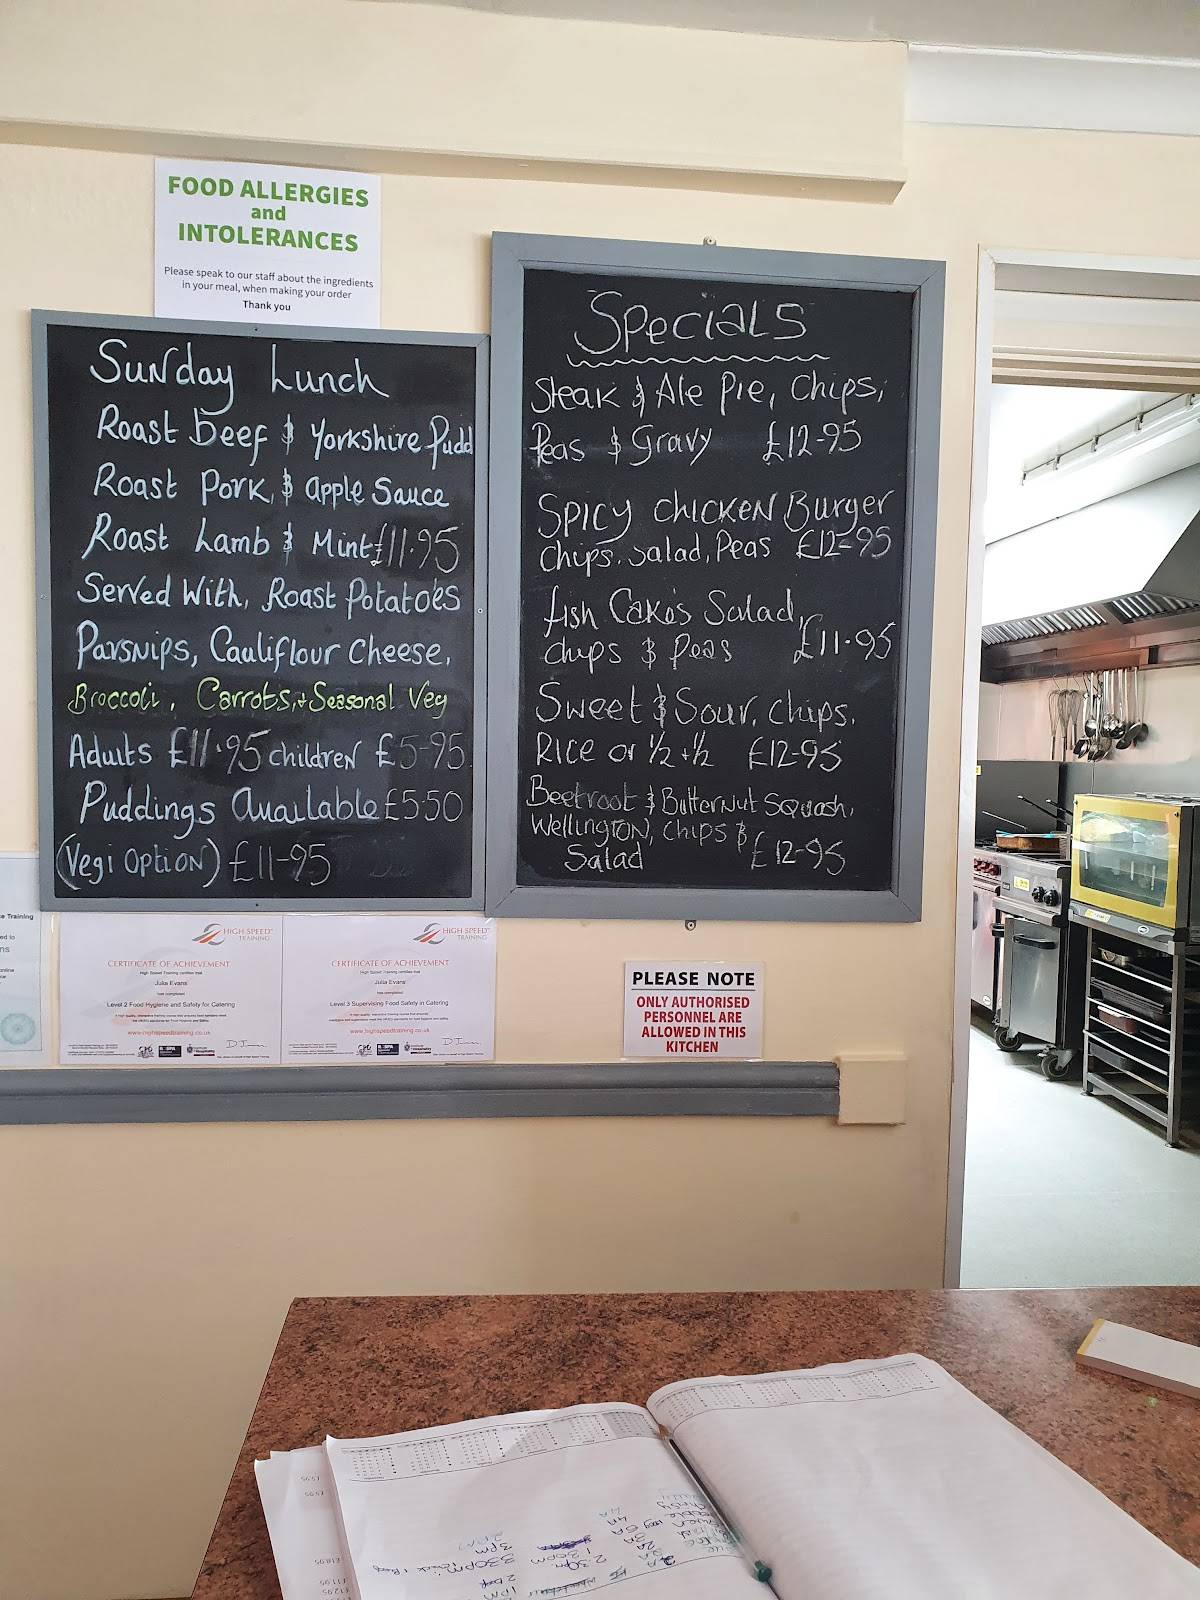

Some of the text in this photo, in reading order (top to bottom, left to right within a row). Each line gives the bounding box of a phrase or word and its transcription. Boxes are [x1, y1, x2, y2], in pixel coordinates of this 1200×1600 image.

[168, 176, 369, 208] FOOD ALLERGIES
[251, 205, 286, 221] and
[178, 223, 359, 252] INTOLERANCES
[164, 267, 194, 276] Please
[197, 268, 223, 279] speak
[237, 272, 253, 280] our
[255, 272, 275, 281] staff
[277, 273, 304, 284] about
[306, 275, 322, 285] the
[323, 276, 374, 288] ingredients
[182, 280, 352, 299] in your meal, when making your order
[243, 300, 291, 312] Thank you
[271, 343, 389, 397] Lunch
[531, 376, 620, 414] Steak
[657, 373, 703, 408] Ale
[97, 403, 179, 446] Roast
[311, 418, 421, 460] Yorkshire
[420, 414, 473, 470] Pudd
[530, 422, 585, 467] Peas
[629, 424, 713, 466] Gravy
[93, 462, 178, 497] Roast
[372, 476, 450, 508] Sauce
[537, 493, 632, 545] Spicy
[783, 490, 895, 537] Burger
[81, 512, 170, 559] Roast
[194, 517, 270, 556] Lamb
[311, 530, 372, 560] Mint
[715, 528, 772, 563] Peas
[77, 572, 171, 608] Served
[262, 577, 337, 612] Roast
[210, 625, 341, 673] Cauliflour
[670, 633, 733, 670] Peas
[308, 681, 394, 713] Seasonal
[409, 681, 448, 719] Veg
[536, 681, 643, 725] Sweet
[69, 733, 153, 768] Adults
[535, 732, 595, 766] Rice
[608, 744, 636, 764] or
[80, 781, 216, 839] Puddings
[526, 774, 638, 812] Beetroot
[661, 786, 757, 816] Butternut
[57, 833, 113, 890] (Vegi
[564, 842, 644, 872] Salad
[7, 913, 34, 921] Training
[107, 960, 231, 968] CERTIFICATE OF ACHIEVEMENT
[393, 959, 450, 967] ACHIEVEMENT
[632, 971, 755, 986] PLEASE NOTE
[636, 996, 750, 1008] ONLY AUTHORISED
[644, 1011, 742, 1023] PERSONNEL ARE
[641, 1026, 746, 1038] ALLOWED IN THIS
[666, 1041, 719, 1053] KITCHEN
